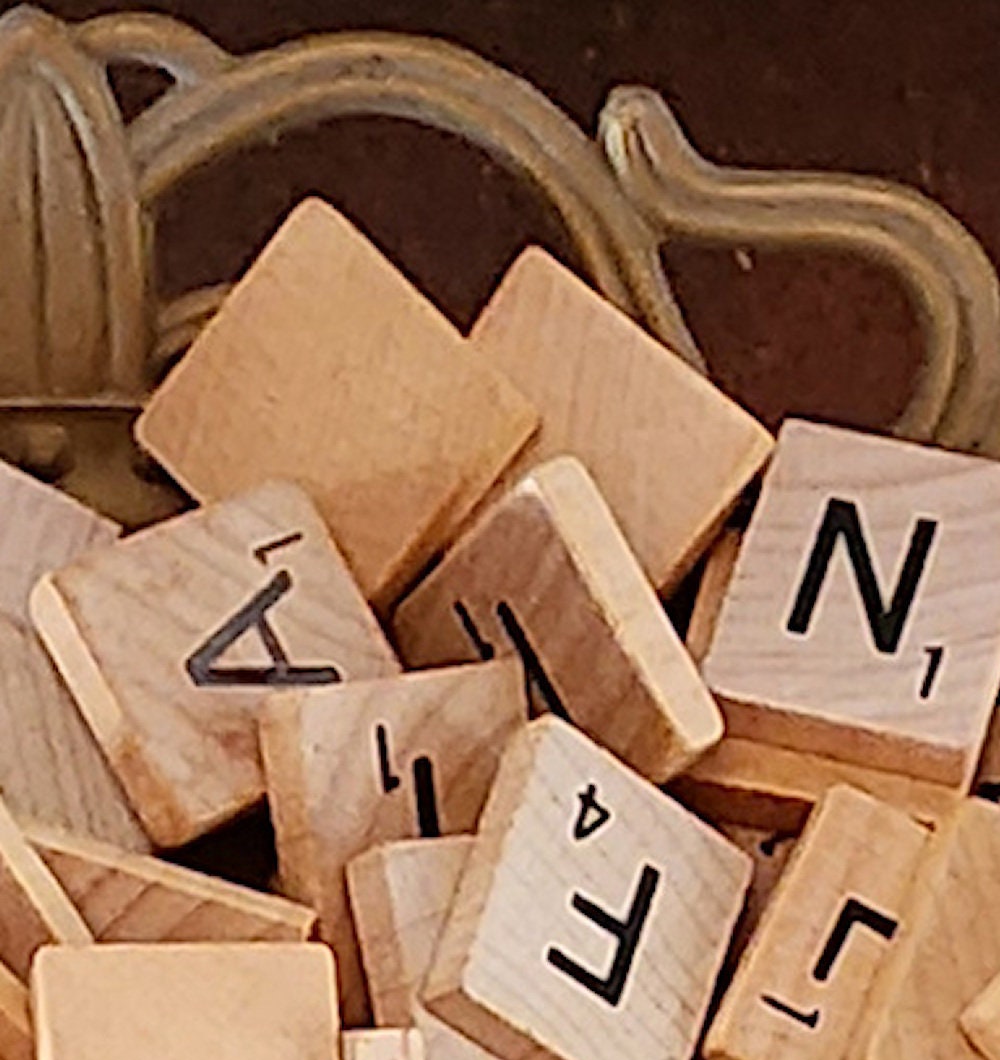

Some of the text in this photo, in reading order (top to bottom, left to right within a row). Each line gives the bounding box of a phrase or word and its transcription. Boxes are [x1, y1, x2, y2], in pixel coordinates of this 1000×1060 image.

[185, 533, 342, 687] A 1
[787, 497, 944, 699] N 1
[376, 725, 401, 794] 1
[547, 784, 661, 1007] F 4
[761, 995, 819, 1029] 1
